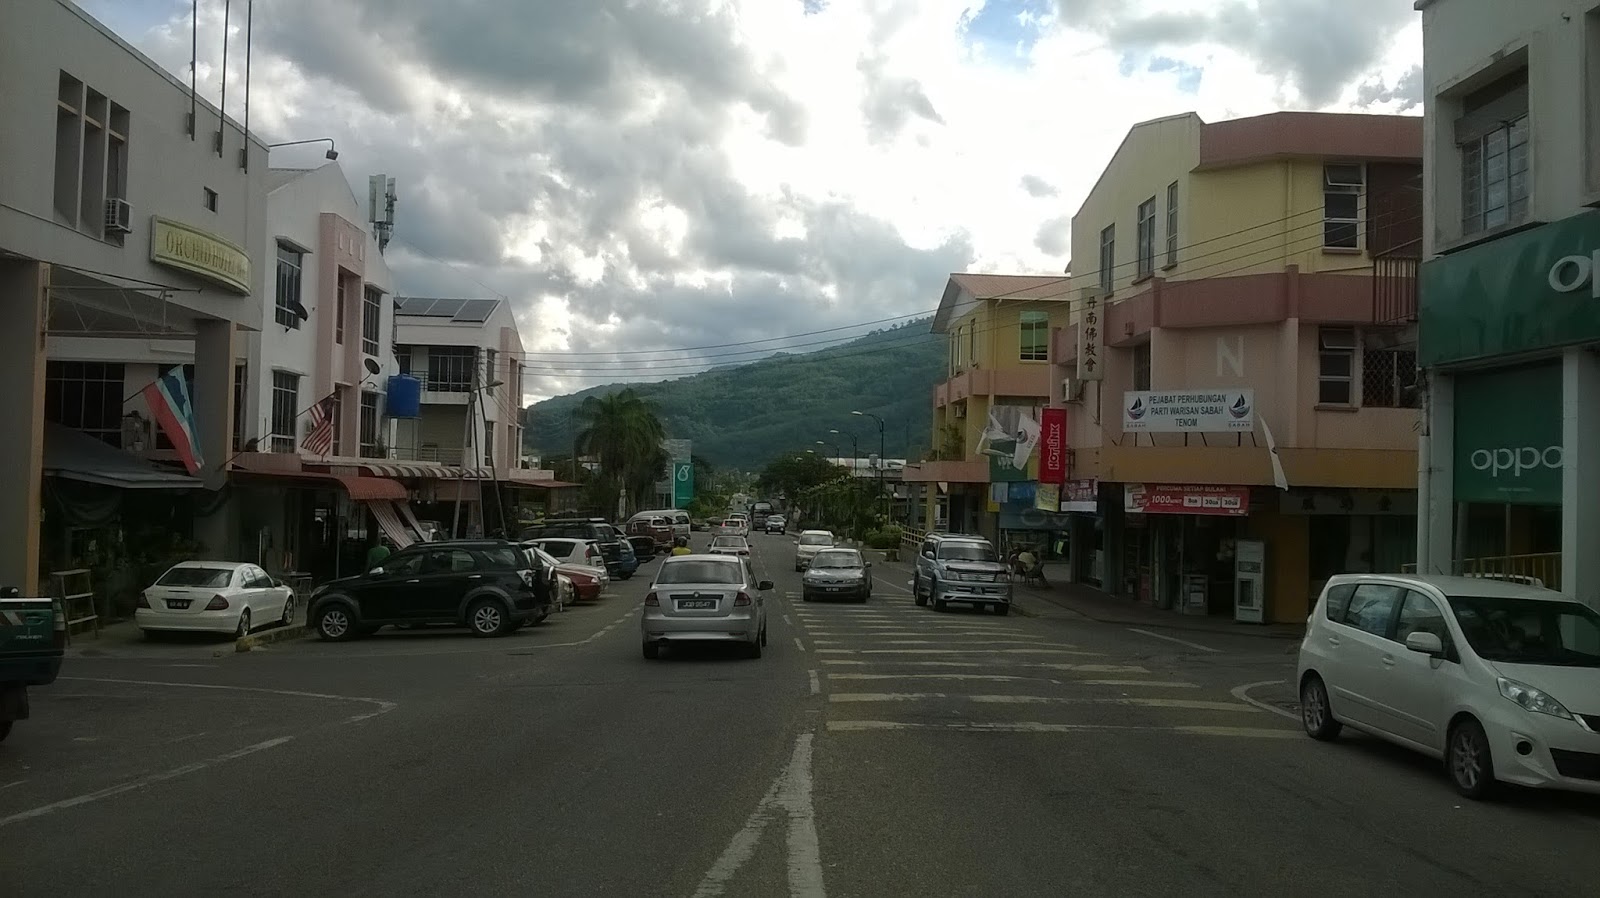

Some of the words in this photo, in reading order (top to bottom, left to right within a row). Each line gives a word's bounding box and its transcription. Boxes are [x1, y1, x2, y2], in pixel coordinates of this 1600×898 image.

[1149, 395, 1176, 404] PEJABAT
[1177, 394, 1227, 403] PERHUBUNGAN
[1151, 407, 1169, 416] PARTI
[1170, 406, 1199, 416] WARISAN
[1200, 406, 1224, 415] SABAH
[1175, 418, 1198, 427] TENOM
[1152, 495, 1171, 504] 1000
